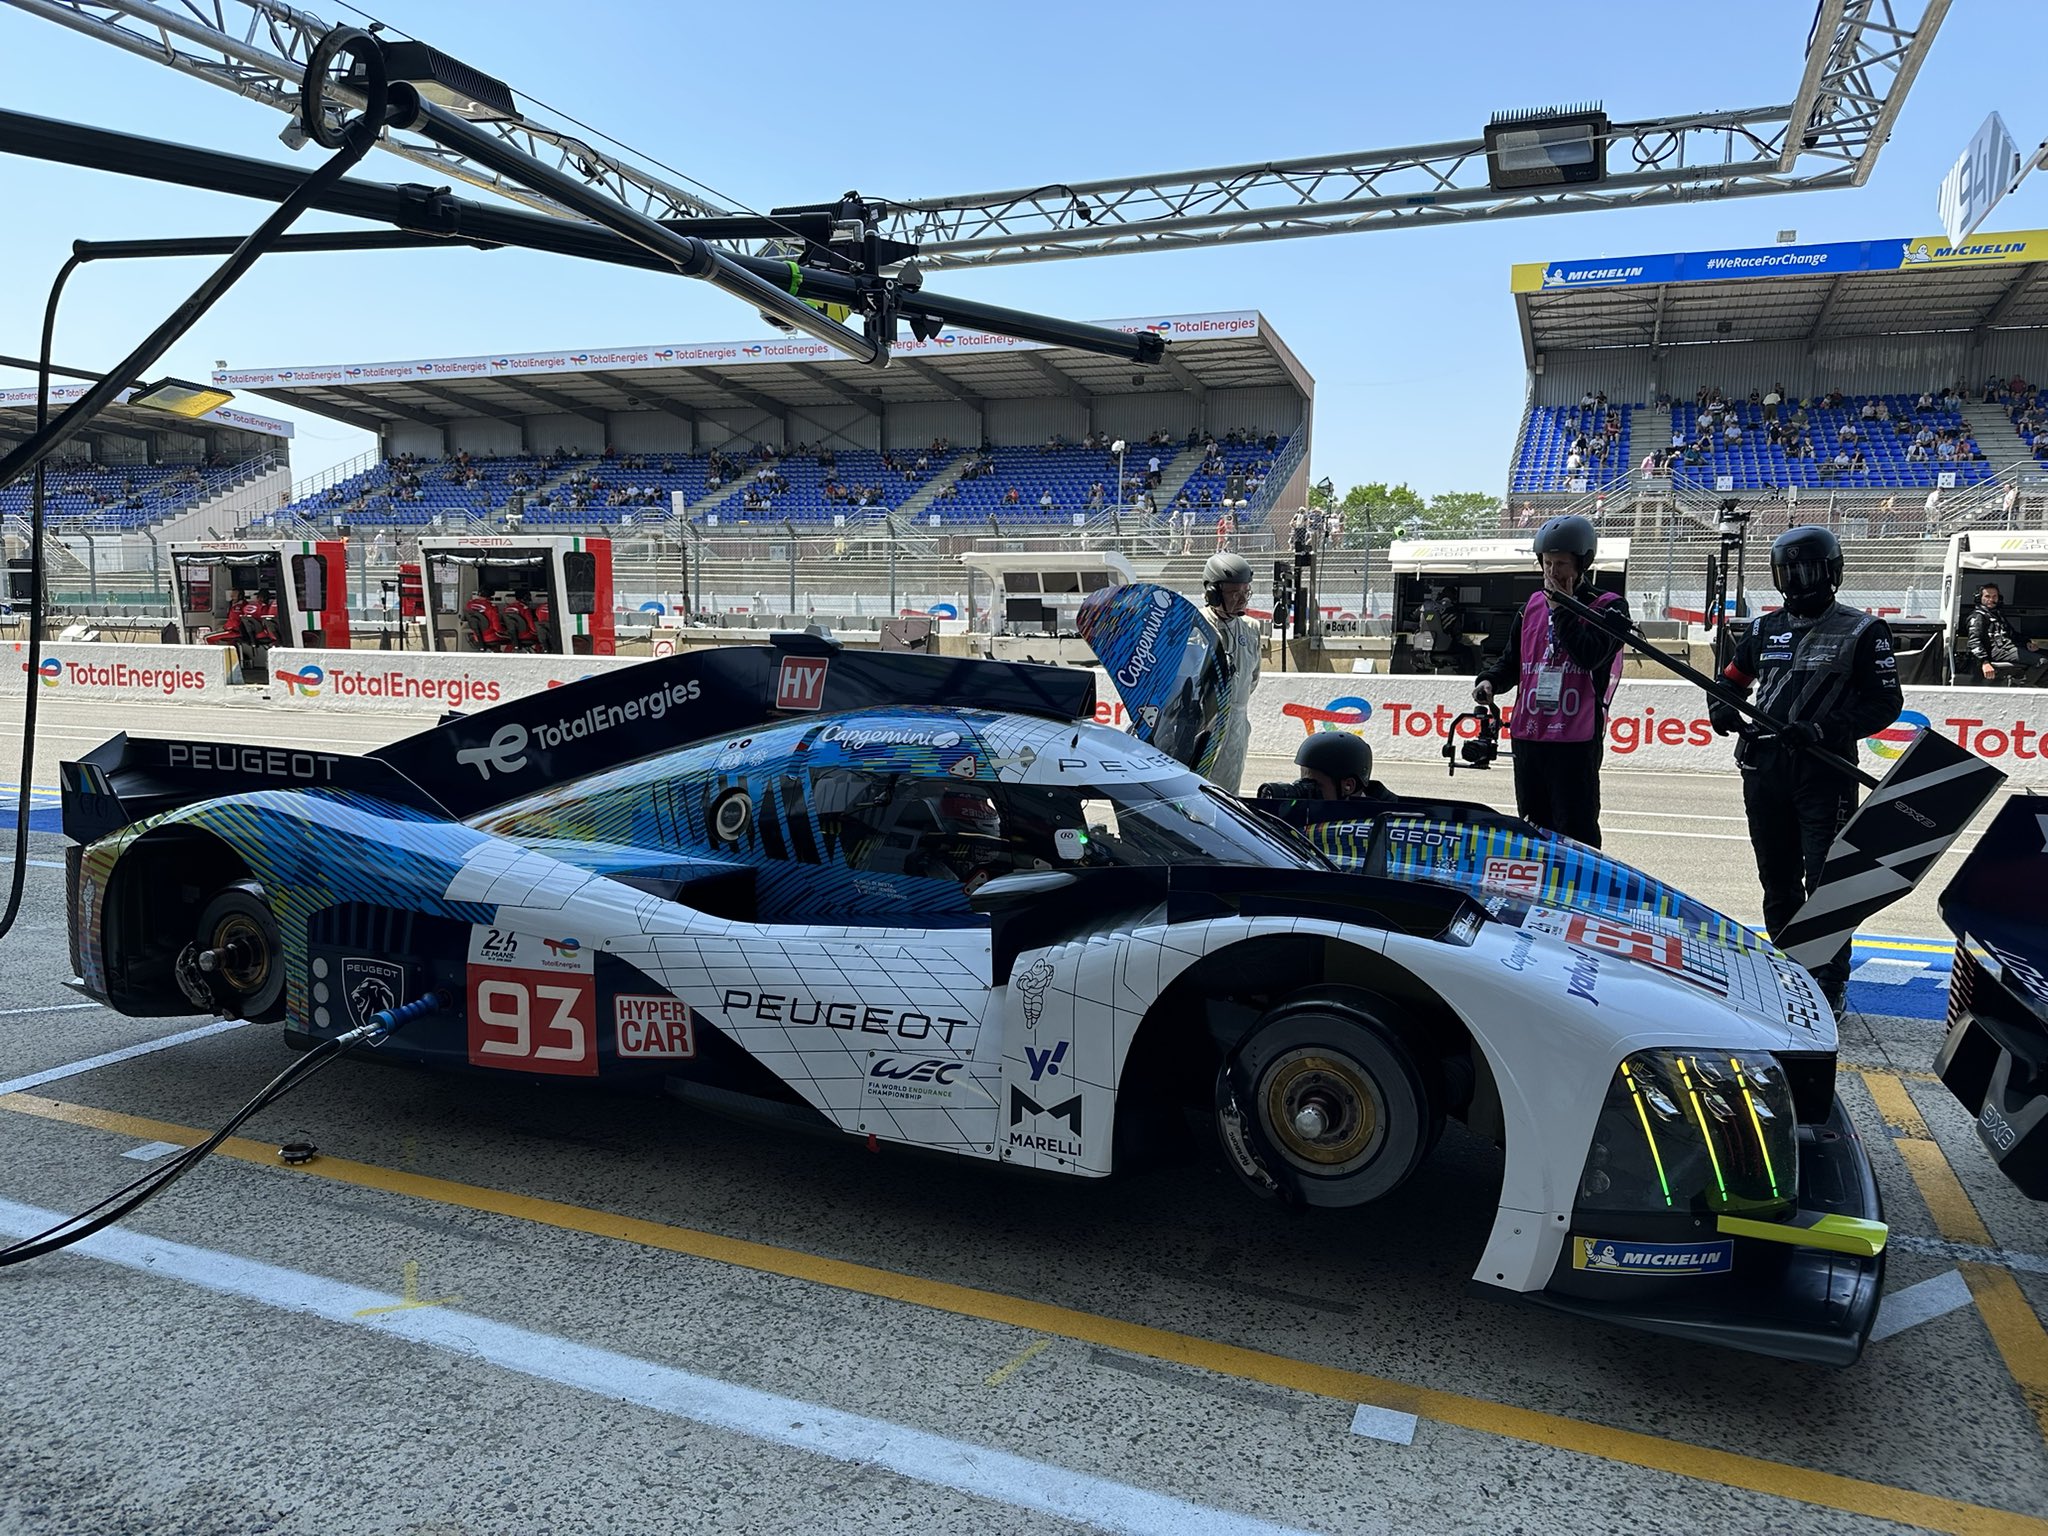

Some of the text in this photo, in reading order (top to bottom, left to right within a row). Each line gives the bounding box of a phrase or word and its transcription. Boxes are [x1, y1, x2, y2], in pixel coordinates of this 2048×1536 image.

[1959, 138, 1990, 234] 94
[1933, 243, 2027, 258] MICHELIN
[1706, 251, 1828, 270] #WeRaceForChange
[1567, 266, 1643, 281] MICHELIN
[1173, 319, 1255, 333] TotalEnergies
[589, 352, 648, 365] TotalEnergies
[675, 348, 736, 360] TotalEnergies
[763, 344, 828, 357] TotalEnergies
[362, 366, 413, 378] TotalEnergies
[434, 362, 487, 374] TotalEnergies
[509, 357, 565, 369] TotalEnergies
[228, 373, 274, 384] TotalEnergies
[293, 371, 342, 382] TotalEnergies
[232, 412, 283, 431] TotalEnergies
[200, 542, 249, 550] PREMA
[457, 538, 514, 546] PREMA
[1331, 621, 1357, 632] Box 14
[1117, 604, 1168, 688] Capgemini
[66, 662, 205, 694] TotalEnergies
[781, 666, 824, 700] HY
[329, 670, 500, 707] TotalEnergies
[532, 679, 701, 750] TotalEnergies
[821, 725, 932, 750] Capgemini
[168, 744, 340, 780] PEUGEOT
[1058, 753, 1177, 773] PEUGE
[1339, 825, 1461, 848] PEGEOT
[483, 929, 518, 952] 24h
[480, 949, 491, 957] LE
[490, 951, 516, 960] MANS
[541, 959, 581, 969] TotalEnergies
[346, 963, 399, 979] PEUGEOT
[1566, 946, 1601, 1007] yahoo!
[619, 1000, 686, 1021] HYPER
[722, 989, 968, 1043] PEUGEOT
[477, 979, 586, 1062] 93
[620, 1021, 689, 1053] CAR
[870, 1058, 964, 1085] WEC
[867, 1088, 922, 1100] CHAMPIONSHIP
[868, 1081, 952, 1098] FIA WORLD ENDURANCE
[1980, 1102, 2016, 1150] 9X8
[1009, 1132, 1082, 1157] MARELLI
[1622, 1252, 1722, 1266] MICHELIN
